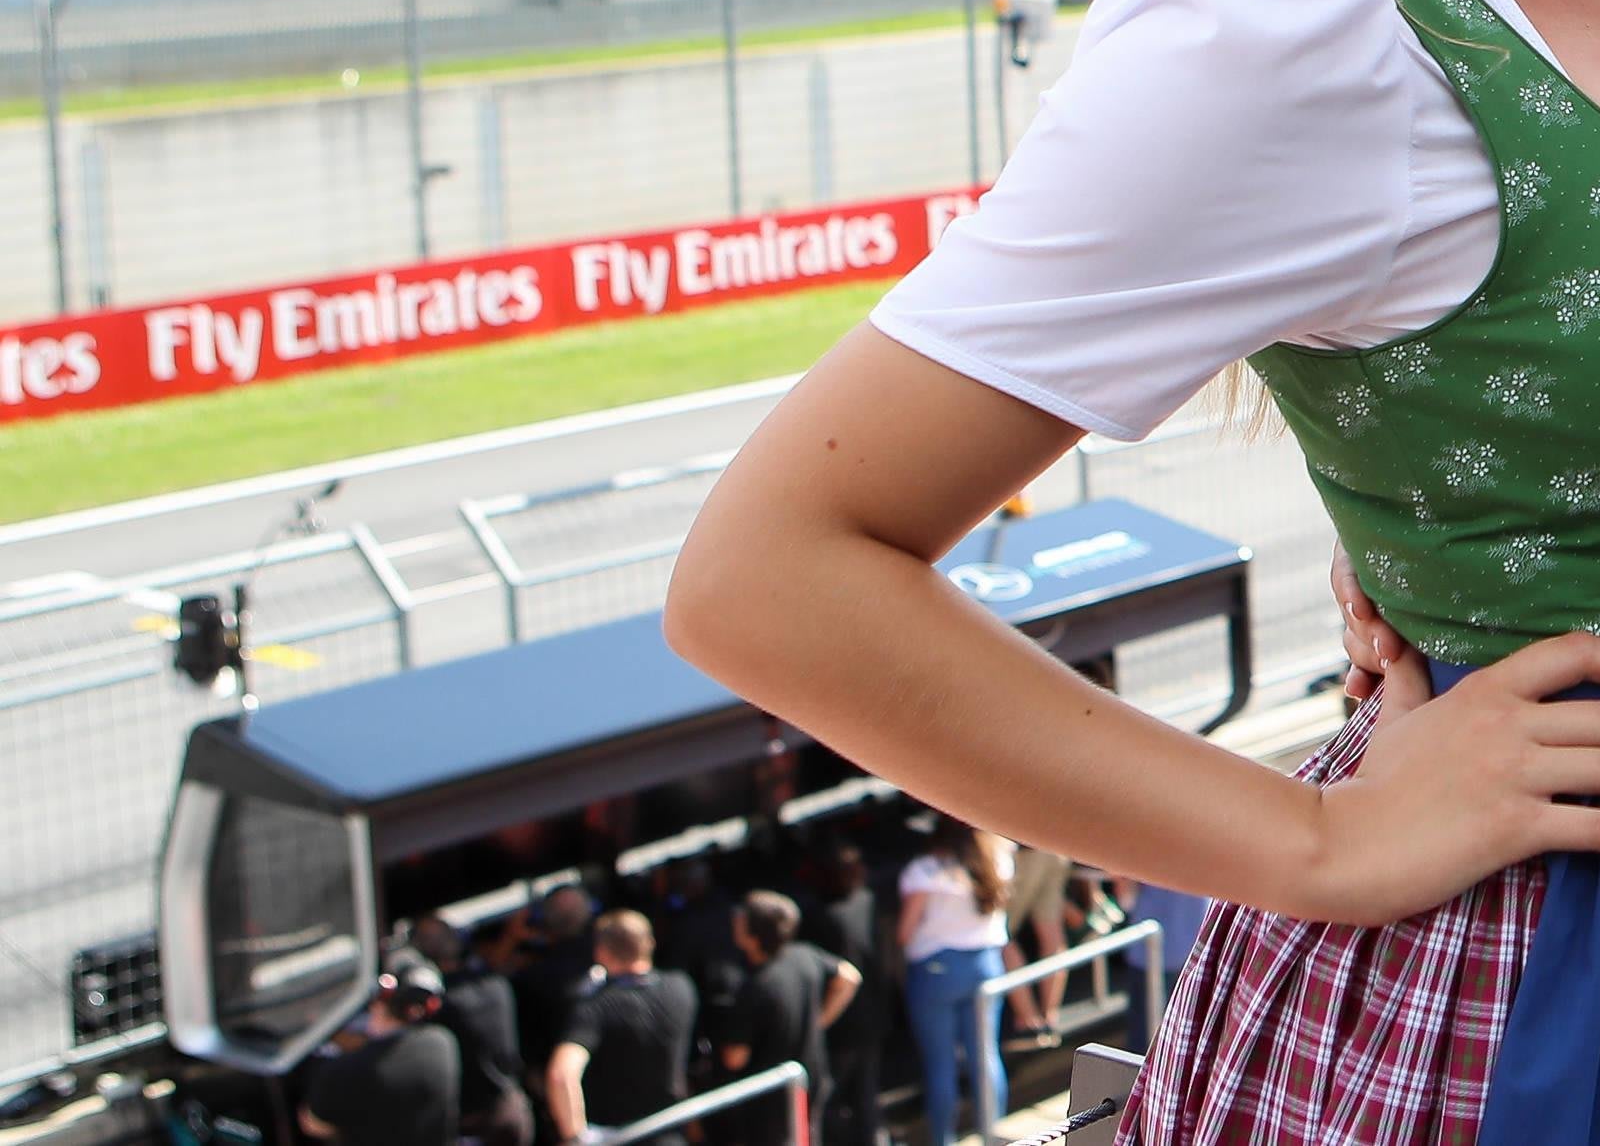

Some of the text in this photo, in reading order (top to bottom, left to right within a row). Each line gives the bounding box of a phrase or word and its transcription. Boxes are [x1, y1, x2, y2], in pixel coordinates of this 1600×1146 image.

[571, 241, 671, 314] Fly
[674, 214, 899, 295] Emirates
[145, 270, 543, 383] Fly Emirates
